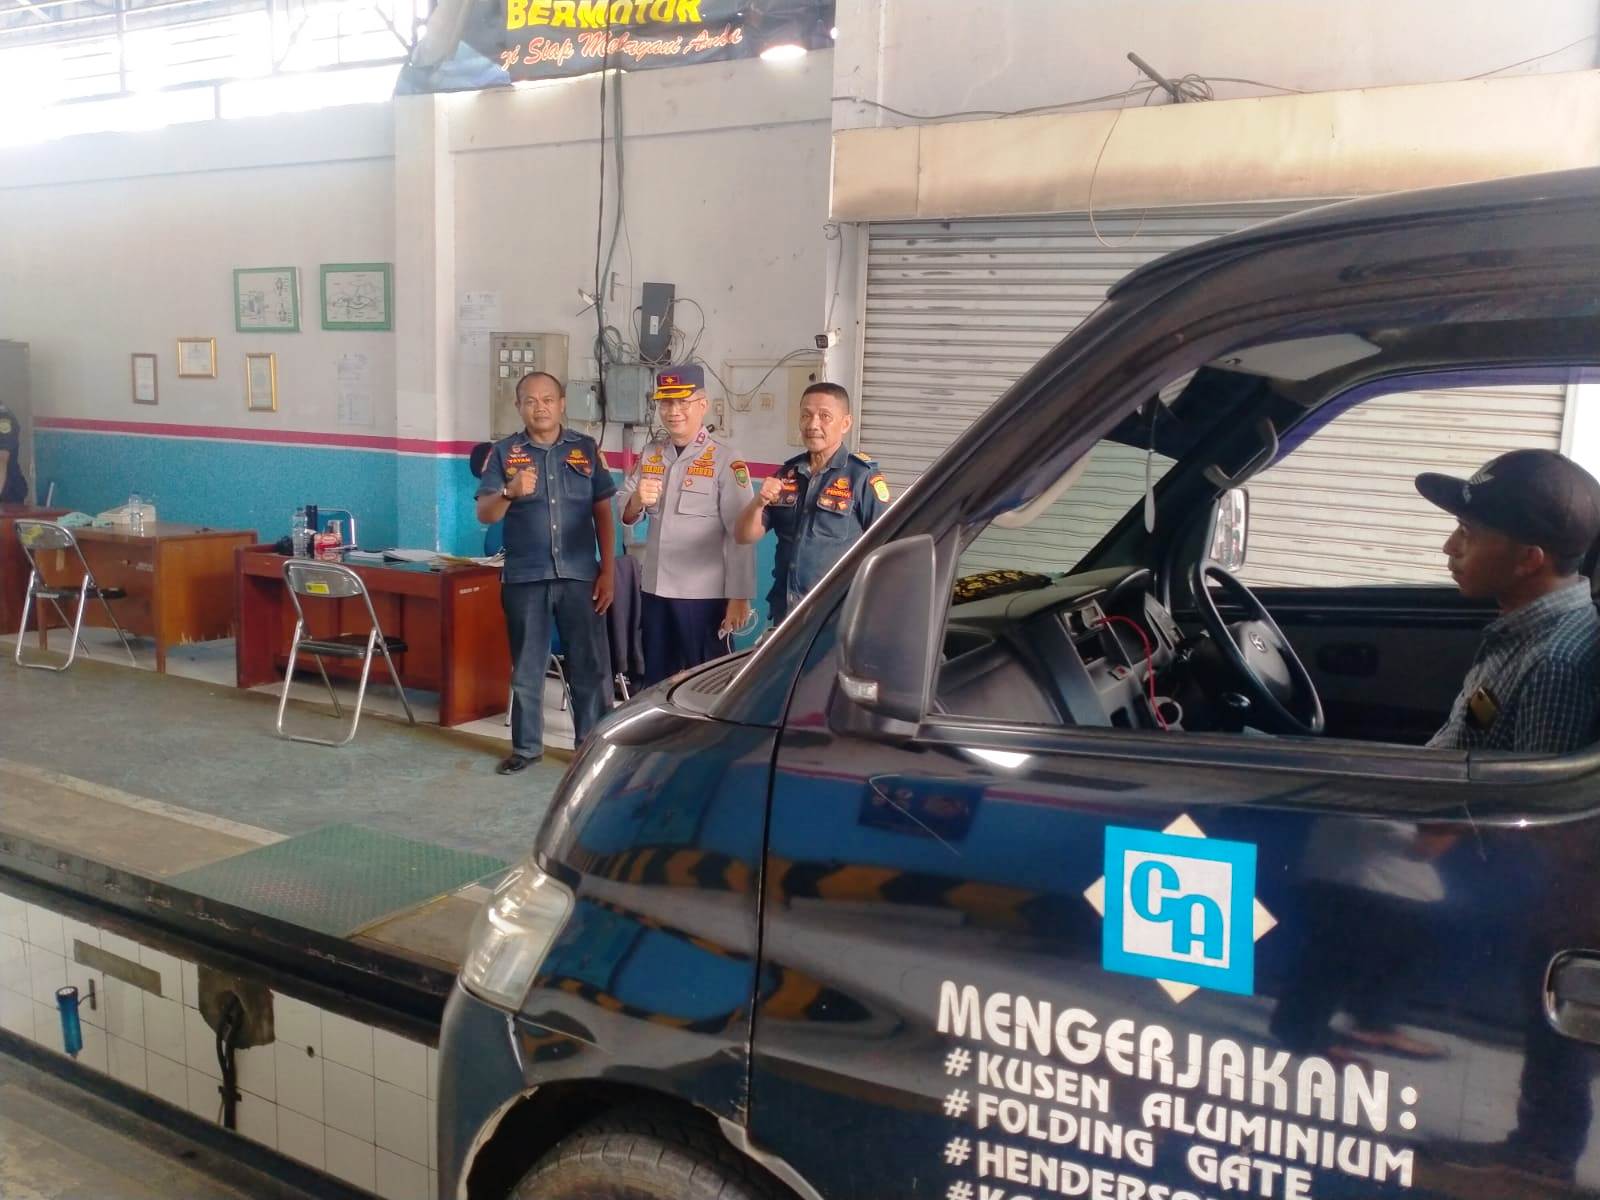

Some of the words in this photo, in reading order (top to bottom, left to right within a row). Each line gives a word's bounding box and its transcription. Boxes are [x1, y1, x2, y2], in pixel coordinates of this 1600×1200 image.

[507, 0, 702, 30] BERMOTOR
[523, 37, 575, 67] Siap
[577, 31, 683, 62] Melayani
[683, 23, 743, 55] Anda
[1130, 859, 1224, 961] CA
[936, 980, 1418, 1132] MENGERJAKAN:
[1142, 1092, 1415, 1187] ALUMINIUM
[1187, 1145, 1314, 1200] GATE
